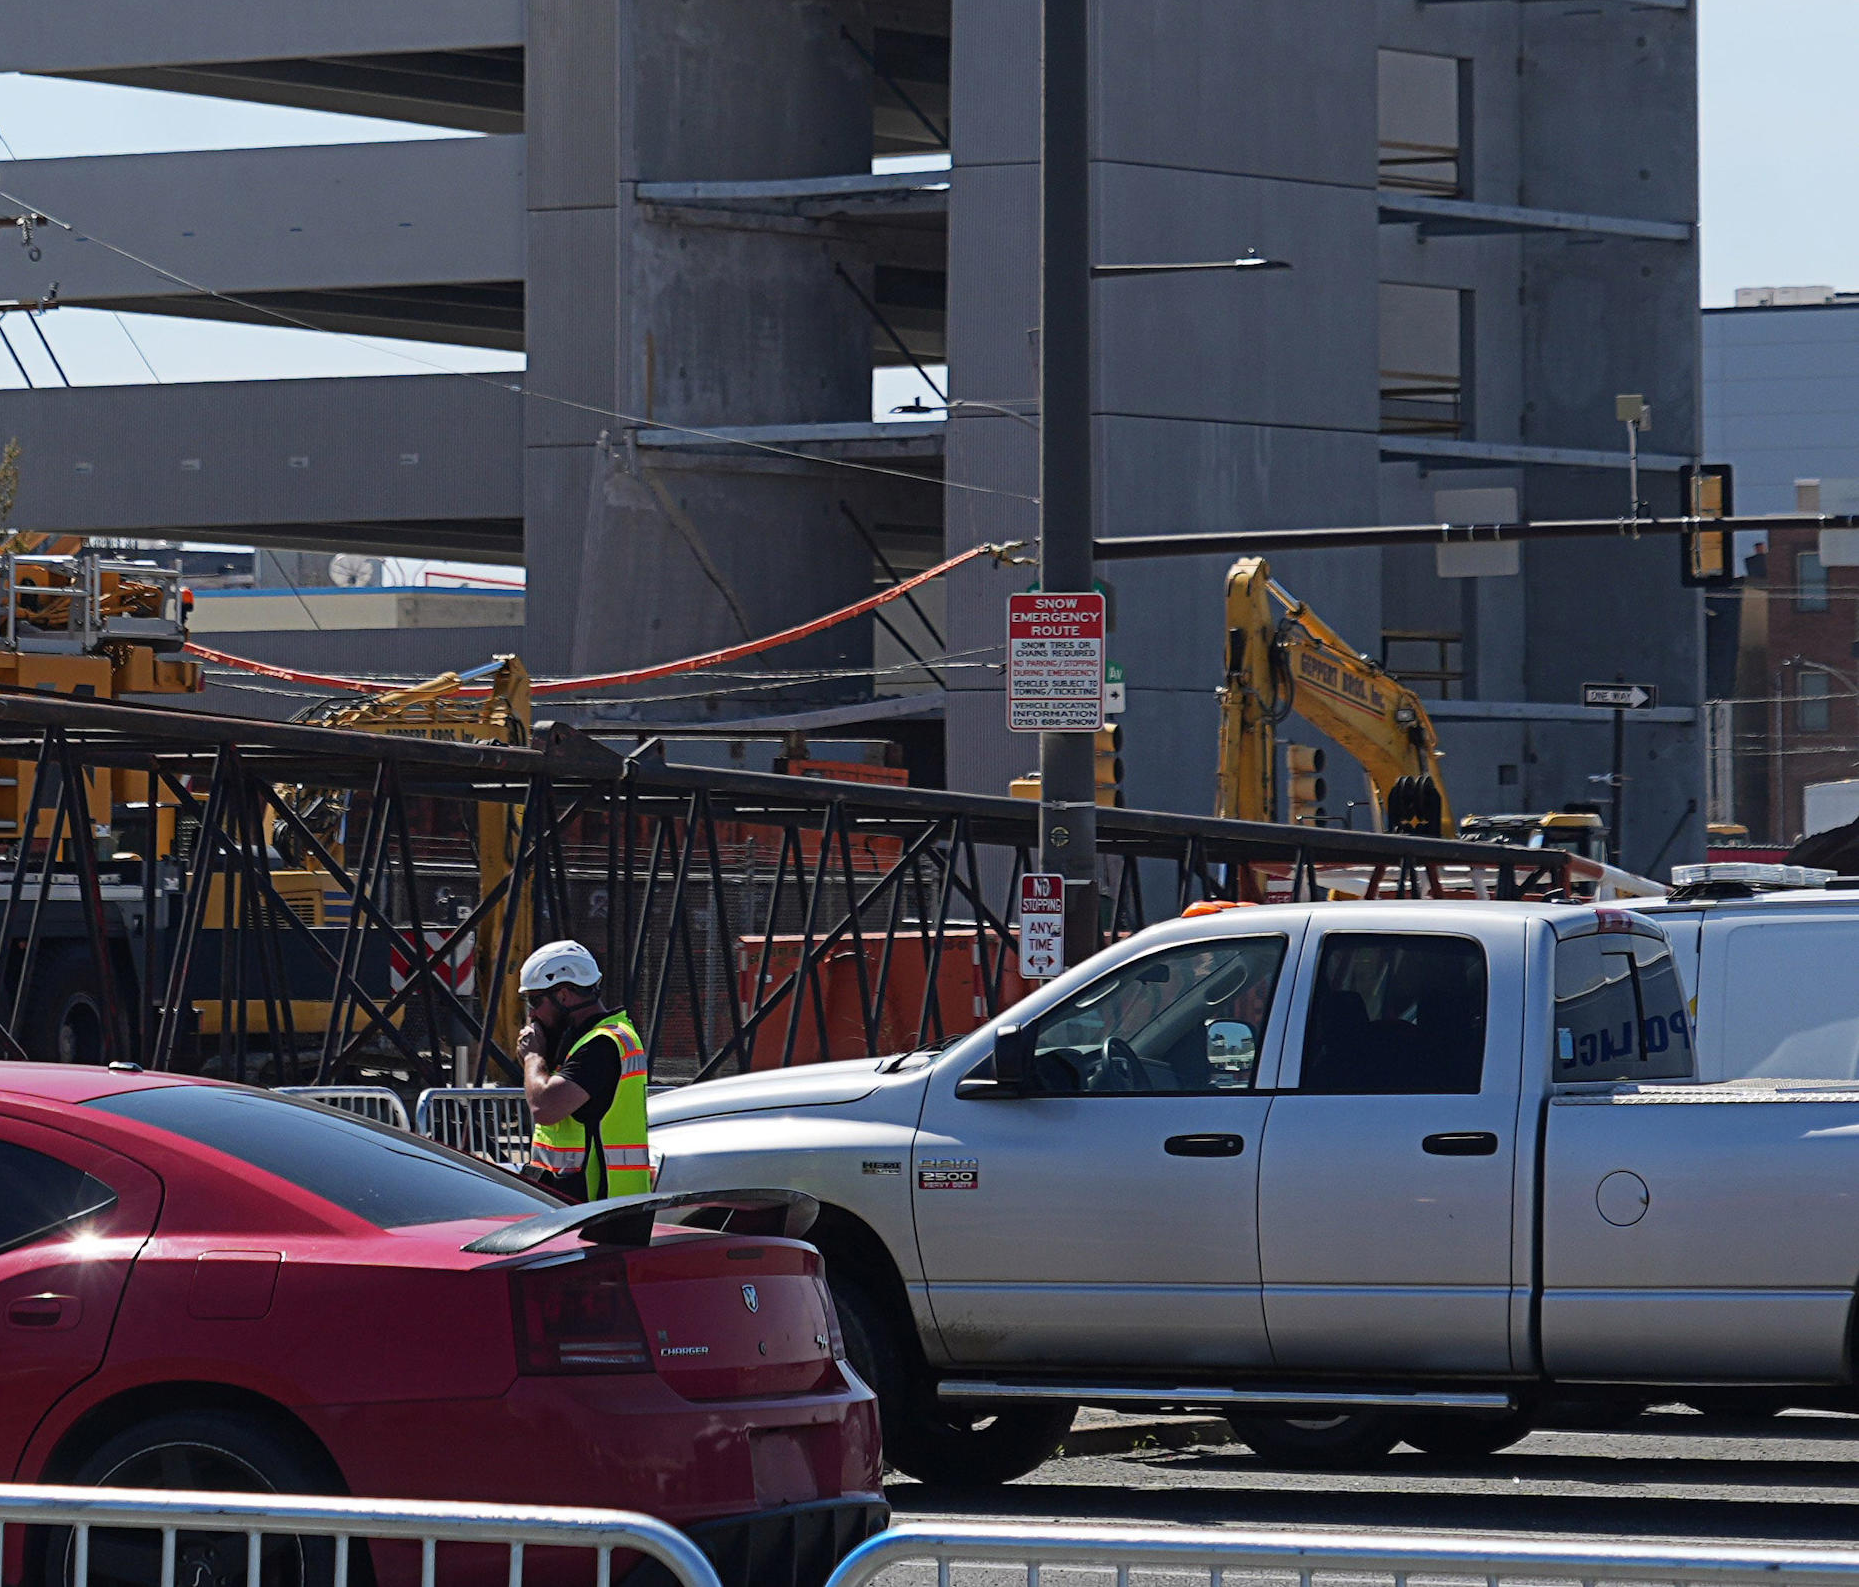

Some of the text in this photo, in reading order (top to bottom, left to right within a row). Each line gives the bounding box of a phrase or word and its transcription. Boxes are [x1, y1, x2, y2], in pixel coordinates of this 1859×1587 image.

[1035, 598, 1078, 609] SNOW
[1011, 612, 1100, 623] EMERGENCY
[1031, 625, 1080, 636] ROUTE
[1021, 641, 1091, 649] SNOW TIRES OR
[1013, 659, 1024, 667] NO
[1013, 669, 1097, 677] DURING EMERGENCY
[1301, 652, 1338, 687] GEPPERT
[1014, 680, 1098, 688] VEHICLES SUBJECT TO
[1590, 691, 1631, 701] ONE WAY
[1013, 718, 1038, 726] (215)
[1032, 878, 1052, 897] NO
[1022, 898, 1062, 911] STOPPING
[1029, 921, 1053, 934] ANY
[1028, 938, 1054, 951] TIME
[862, 1161, 902, 1169] HEMI
[922, 1172, 973, 1181] 2500
[660, 1346, 709, 1357] CHARGER
